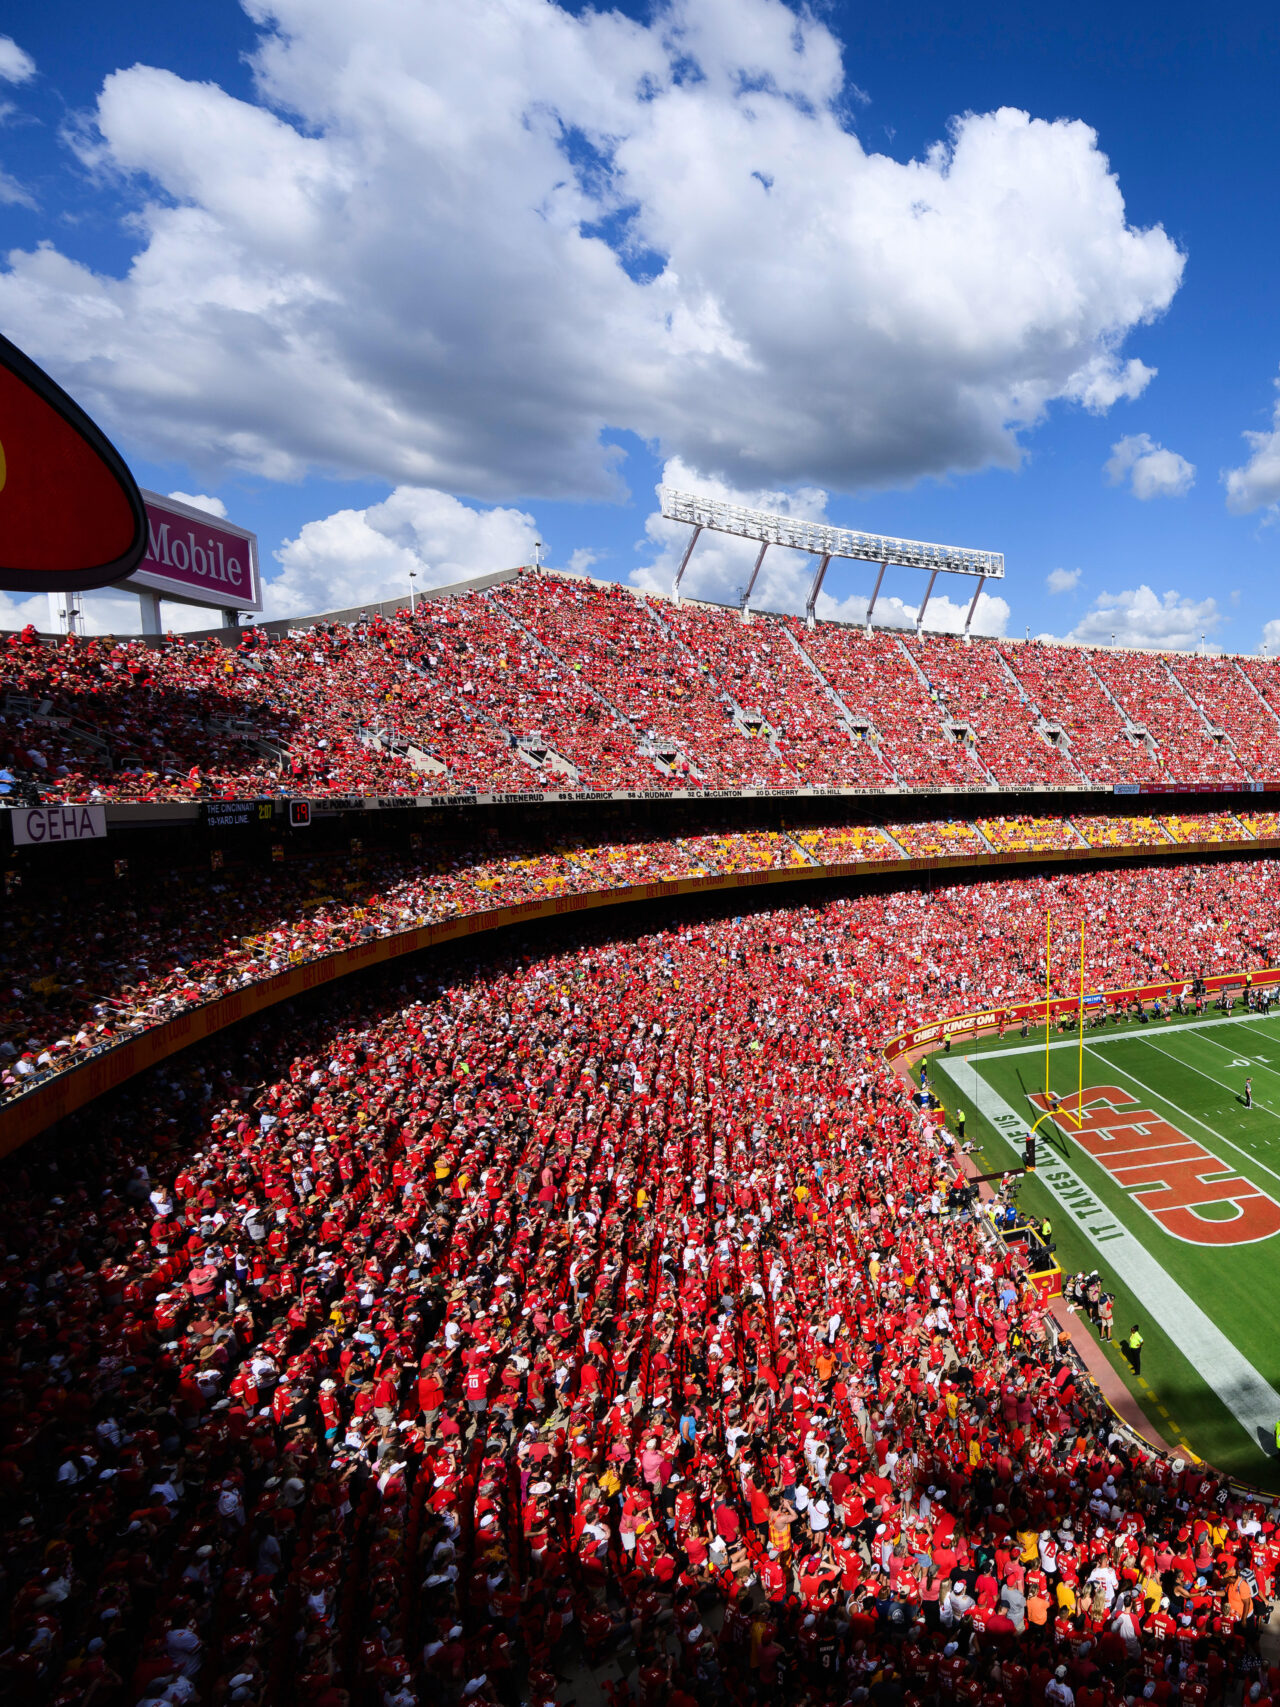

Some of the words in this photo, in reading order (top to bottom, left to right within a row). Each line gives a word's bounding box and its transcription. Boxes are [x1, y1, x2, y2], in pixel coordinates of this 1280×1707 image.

[146, 518, 242, 586] Mobile
[448, 796, 477, 804] HAYNES
[505, 794, 544, 802] STENERUD
[207, 804, 220, 814] THE
[221, 802, 255, 813] CINCINNATI
[258, 804, 272, 820] 2:07
[295, 804, 308, 821] 19
[27, 807, 97, 842] GEHA
[207, 815, 233, 826] 19-YARD
[646, 885, 658, 897] GET
[555, 900, 567, 913] GET
[1232, 1055, 1275, 1066] 10
[993, 1114, 1021, 1129] US
[1045, 1171, 1103, 1220] TAKES
[1088, 1224, 1124, 1242] IT
[1216, 1490, 1228, 1504] 28
[1154, 1627, 1165, 1641] 15
